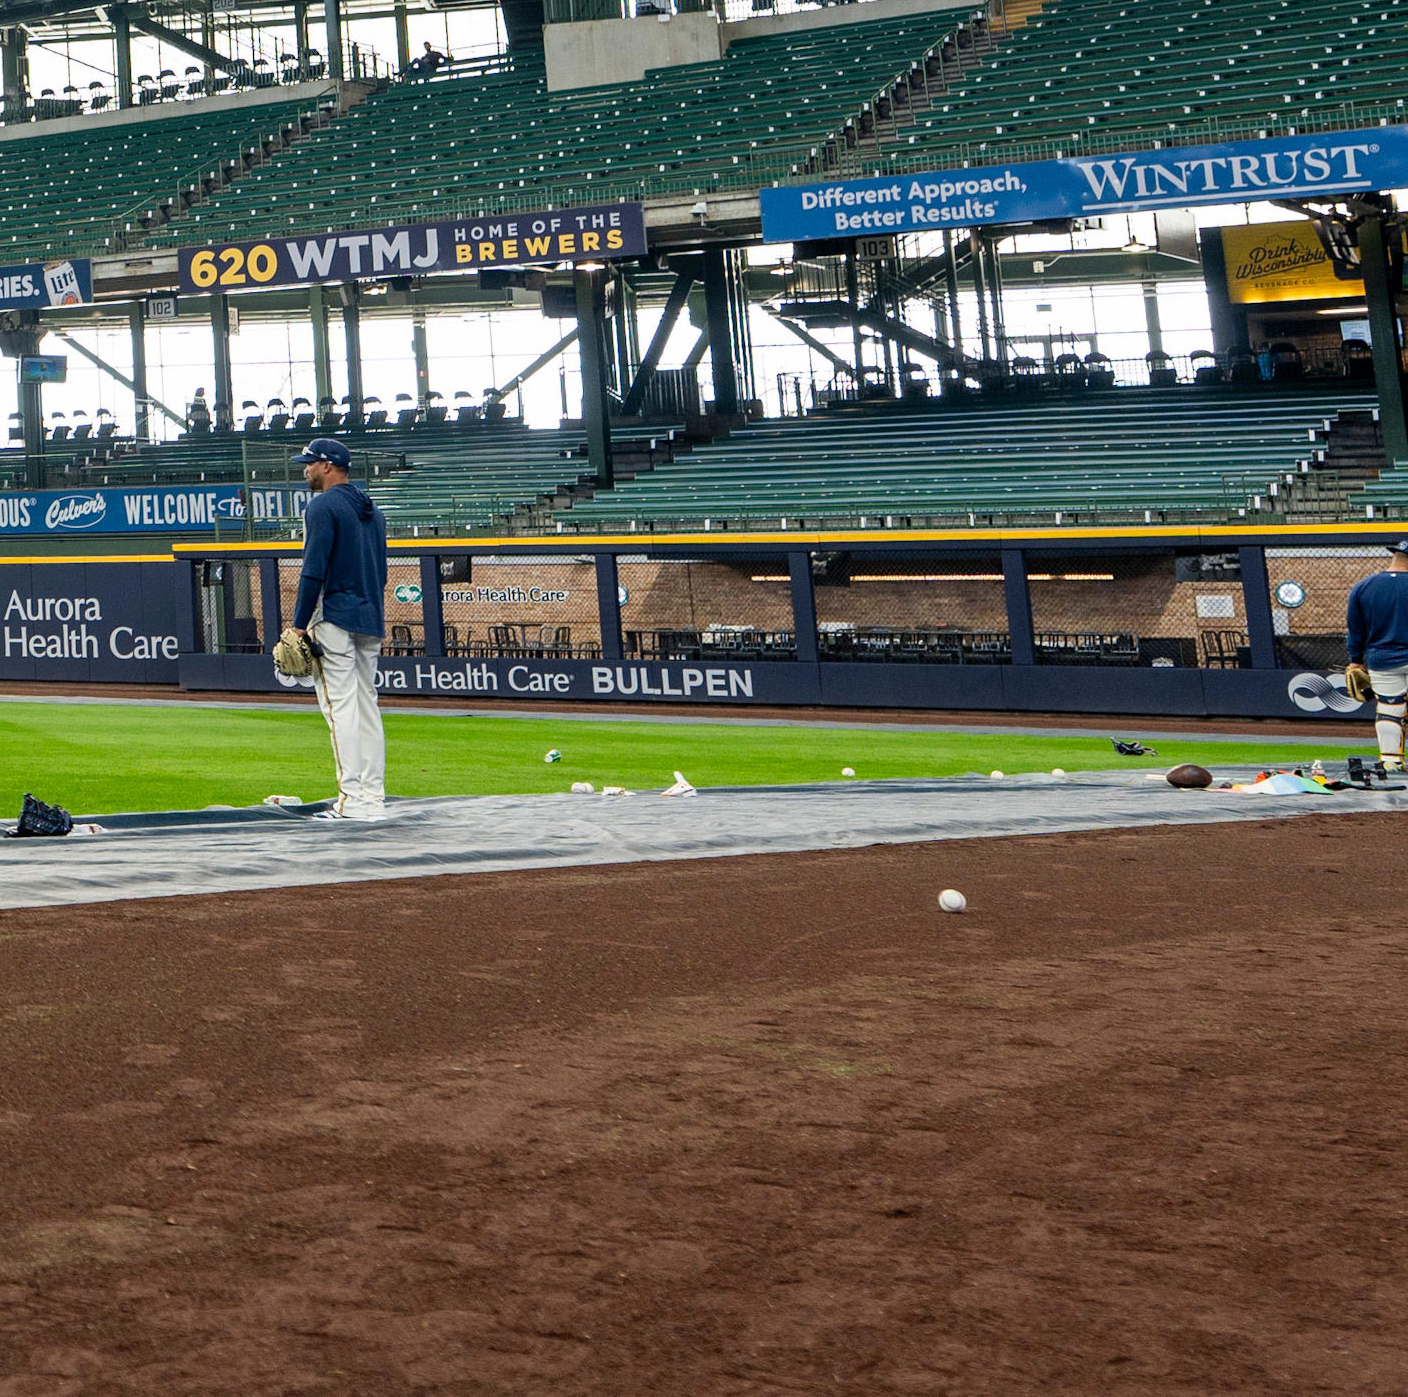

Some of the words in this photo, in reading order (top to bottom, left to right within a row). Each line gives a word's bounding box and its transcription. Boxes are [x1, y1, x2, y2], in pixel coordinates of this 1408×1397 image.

[801, 184, 901, 211] Different
[908, 172, 1027, 205] Approach,
[454, 221, 519, 243] HOME
[531, 217, 562, 234] OF
[576, 211, 622, 229] THE
[835, 205, 906, 231] Better
[190, 244, 278, 288] 620
[286, 228, 440, 279] WTMJ
[456, 229, 624, 264] BREWERS
[861, 240, 889, 257] 103
[1249, 238, 1299, 263] Drink
[50, 270, 75, 294] Lite
[151, 301, 171, 316] 102
[45, 493, 107, 529] Culver's
[125, 492, 216, 525] WELCOME
[3, 589, 102, 622] Aurora
[477, 586, 527, 604] Health
[529, 587, 569, 603] Care
[3, 624, 101, 660] Health
[109, 626, 179, 660] Care
[415, 662, 499, 691] Health
[507, 665, 571, 693] Care
[592, 666, 755, 698] BULLPEN
